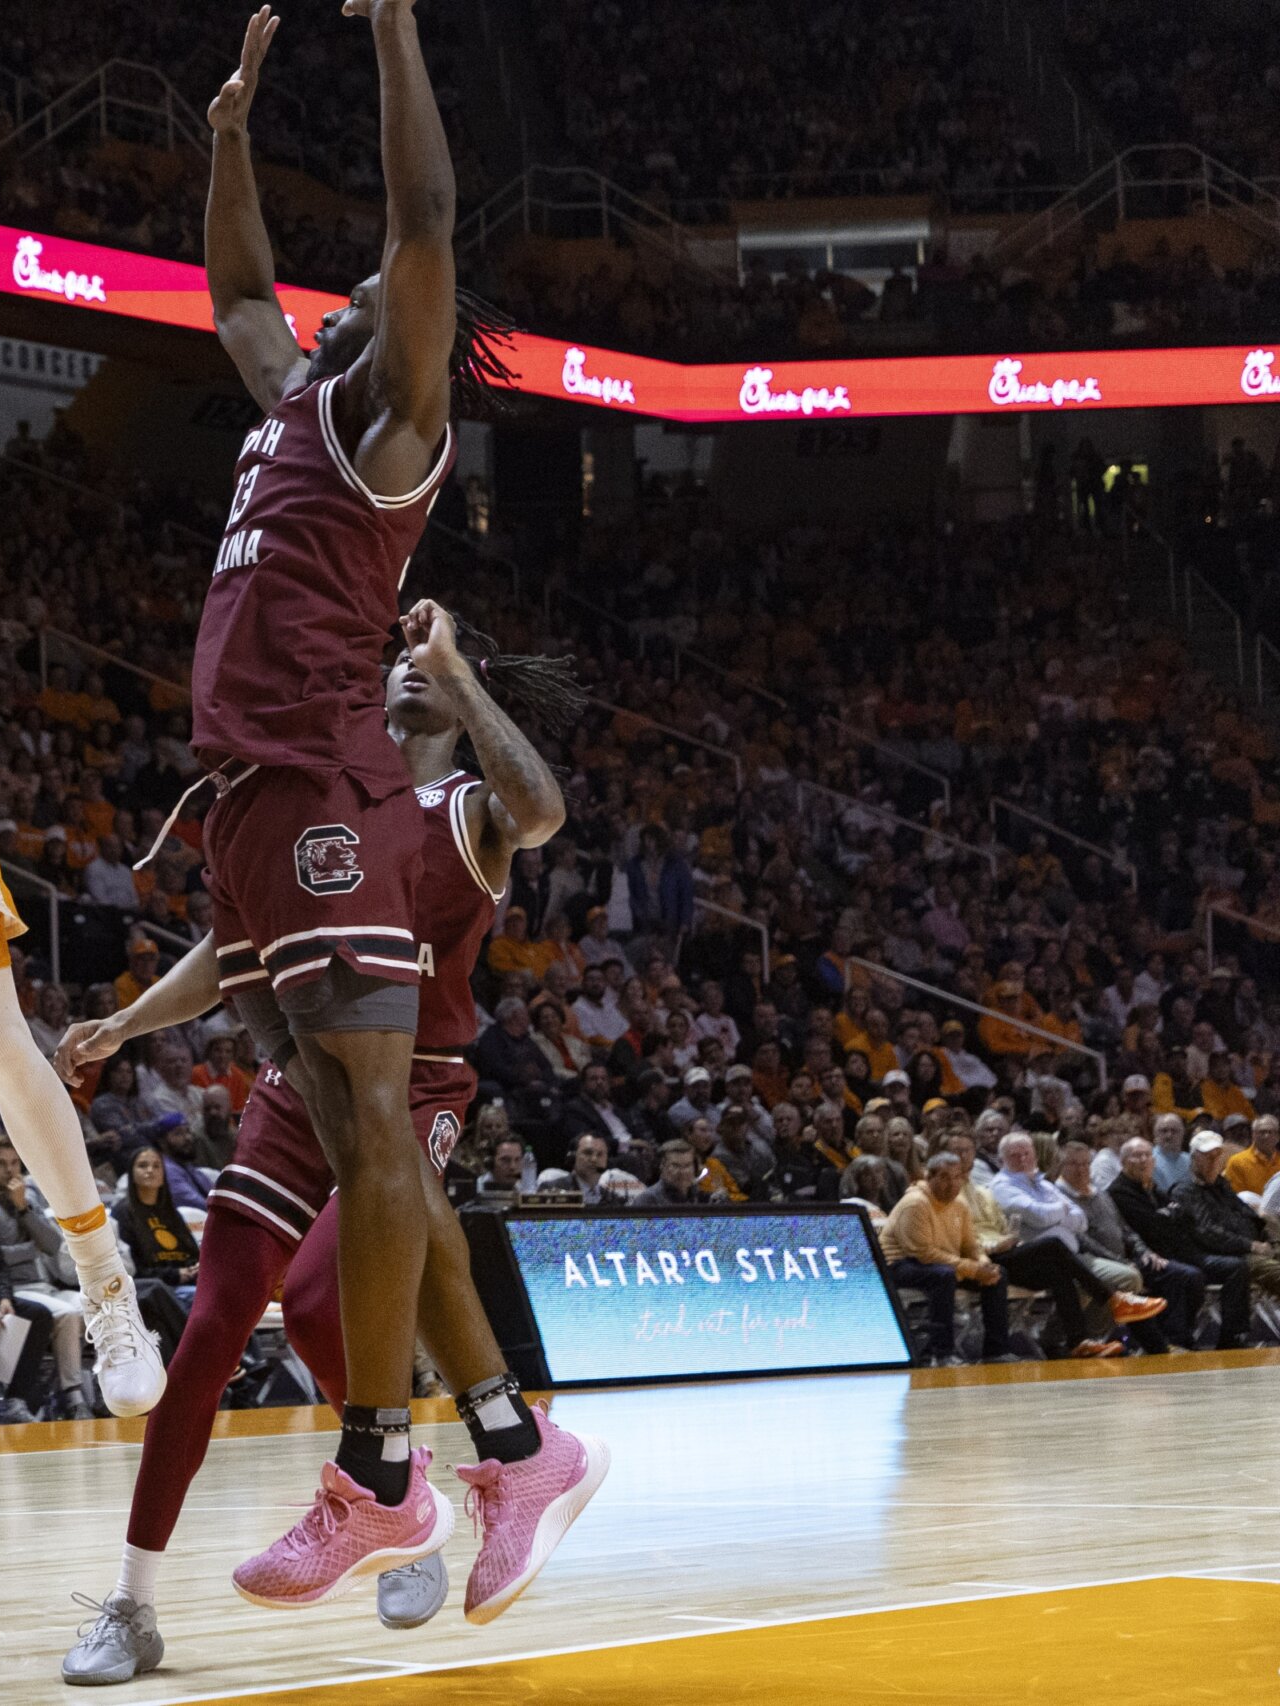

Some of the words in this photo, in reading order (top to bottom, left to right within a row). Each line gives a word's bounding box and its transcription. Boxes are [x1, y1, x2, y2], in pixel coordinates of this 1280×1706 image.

[12, 236, 107, 302] Chick-fil-A
[562, 347, 635, 404] Chick-fil-A
[739, 366, 851, 415] Chick-fil-A
[988, 358, 1102, 406] Chick-fil-A
[735, 1245, 848, 1283] STATE
